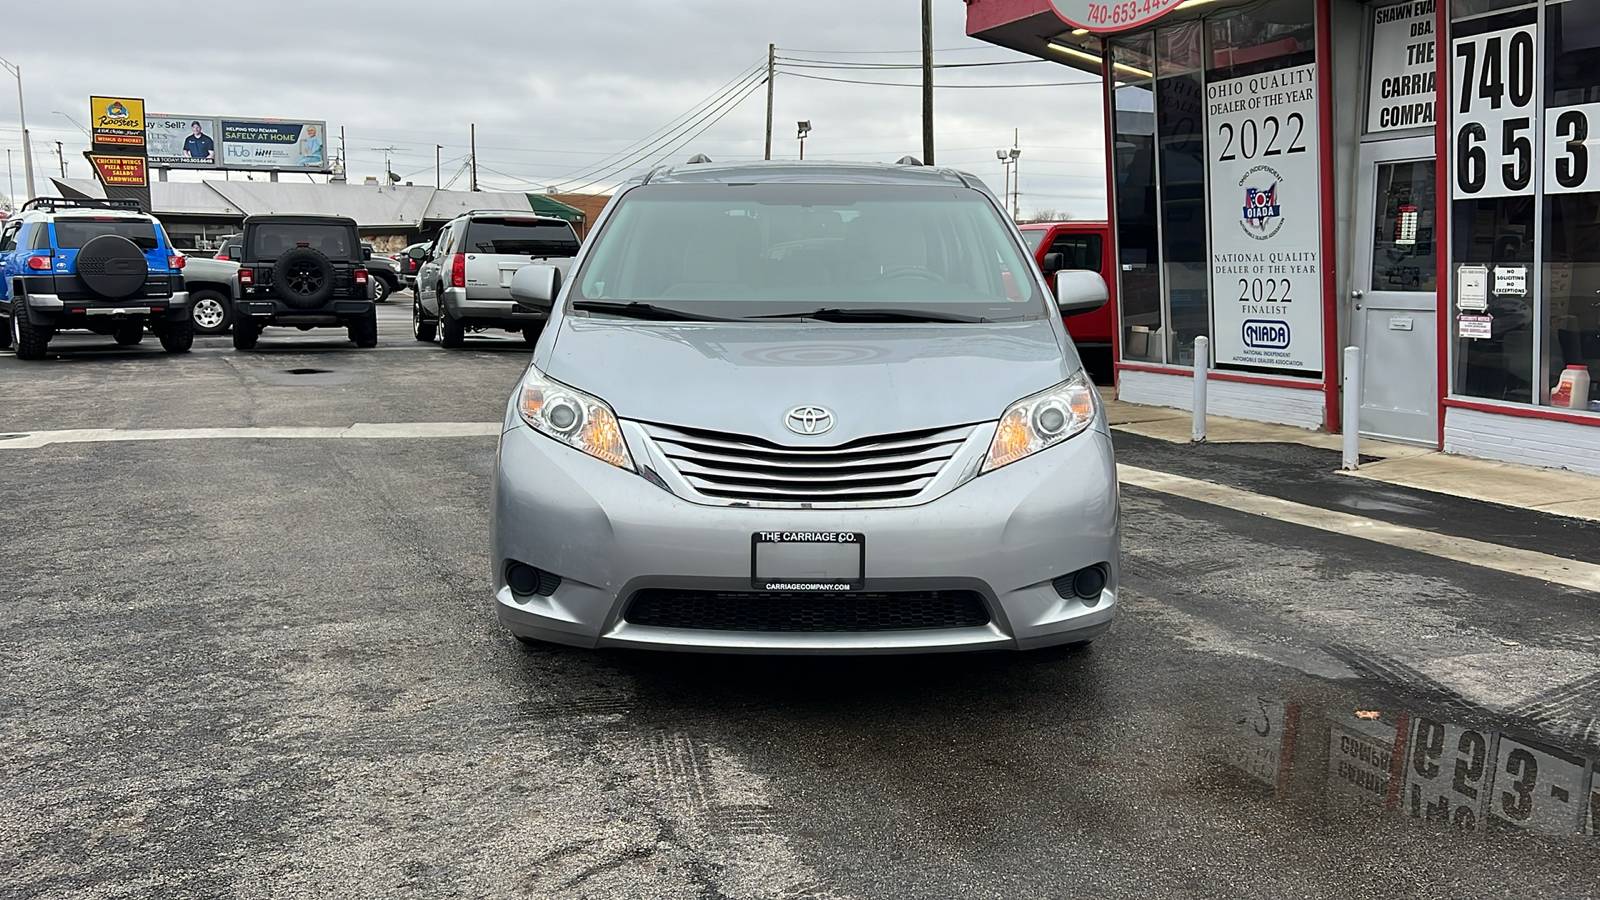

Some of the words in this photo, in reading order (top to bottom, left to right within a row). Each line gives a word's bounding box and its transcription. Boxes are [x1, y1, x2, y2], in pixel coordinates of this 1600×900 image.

[1376, 4, 1412, 24] SHAWN
[1414, 0, 1436, 17] EVA
[1410, 20, 1434, 37] DBA.
[1407, 41, 1435, 66] THE
[1456, 31, 1533, 114] 740
[1208, 82, 1243, 99] OHIO
[1249, 68, 1315, 94] QUALITY
[1381, 71, 1436, 99] CARRIA
[1210, 99, 1246, 116] DEALER
[1248, 97, 1261, 110] OF
[1263, 93, 1283, 107] THE
[1286, 88, 1314, 103] YEAR
[98, 115, 139, 128] Roosters
[164, 121, 186, 129] Sell?
[1380, 101, 1436, 128] COMPA
[225, 132, 256, 140] SAFELY
[1218, 112, 1306, 162] 2022
[1555, 110, 1588, 188] 3
[1247, 206, 1274, 218] OIADA
[1214, 253, 1265, 263] NATIONAL
[1269, 252, 1317, 263] QUALITY
[1215, 265, 1249, 274] DEALER
[1253, 265, 1264, 274] OF
[1268, 265, 1286, 274] THE
[1290, 265, 1316, 274] YEAR
[1238, 278, 1292, 303] 2022
[1242, 305, 1287, 314] FINALIST
[1246, 325, 1286, 343] NIADA
[760, 532, 780, 541] THE
[782, 532, 836, 541] CARRIAGE
[838, 532, 856, 542] CO.
